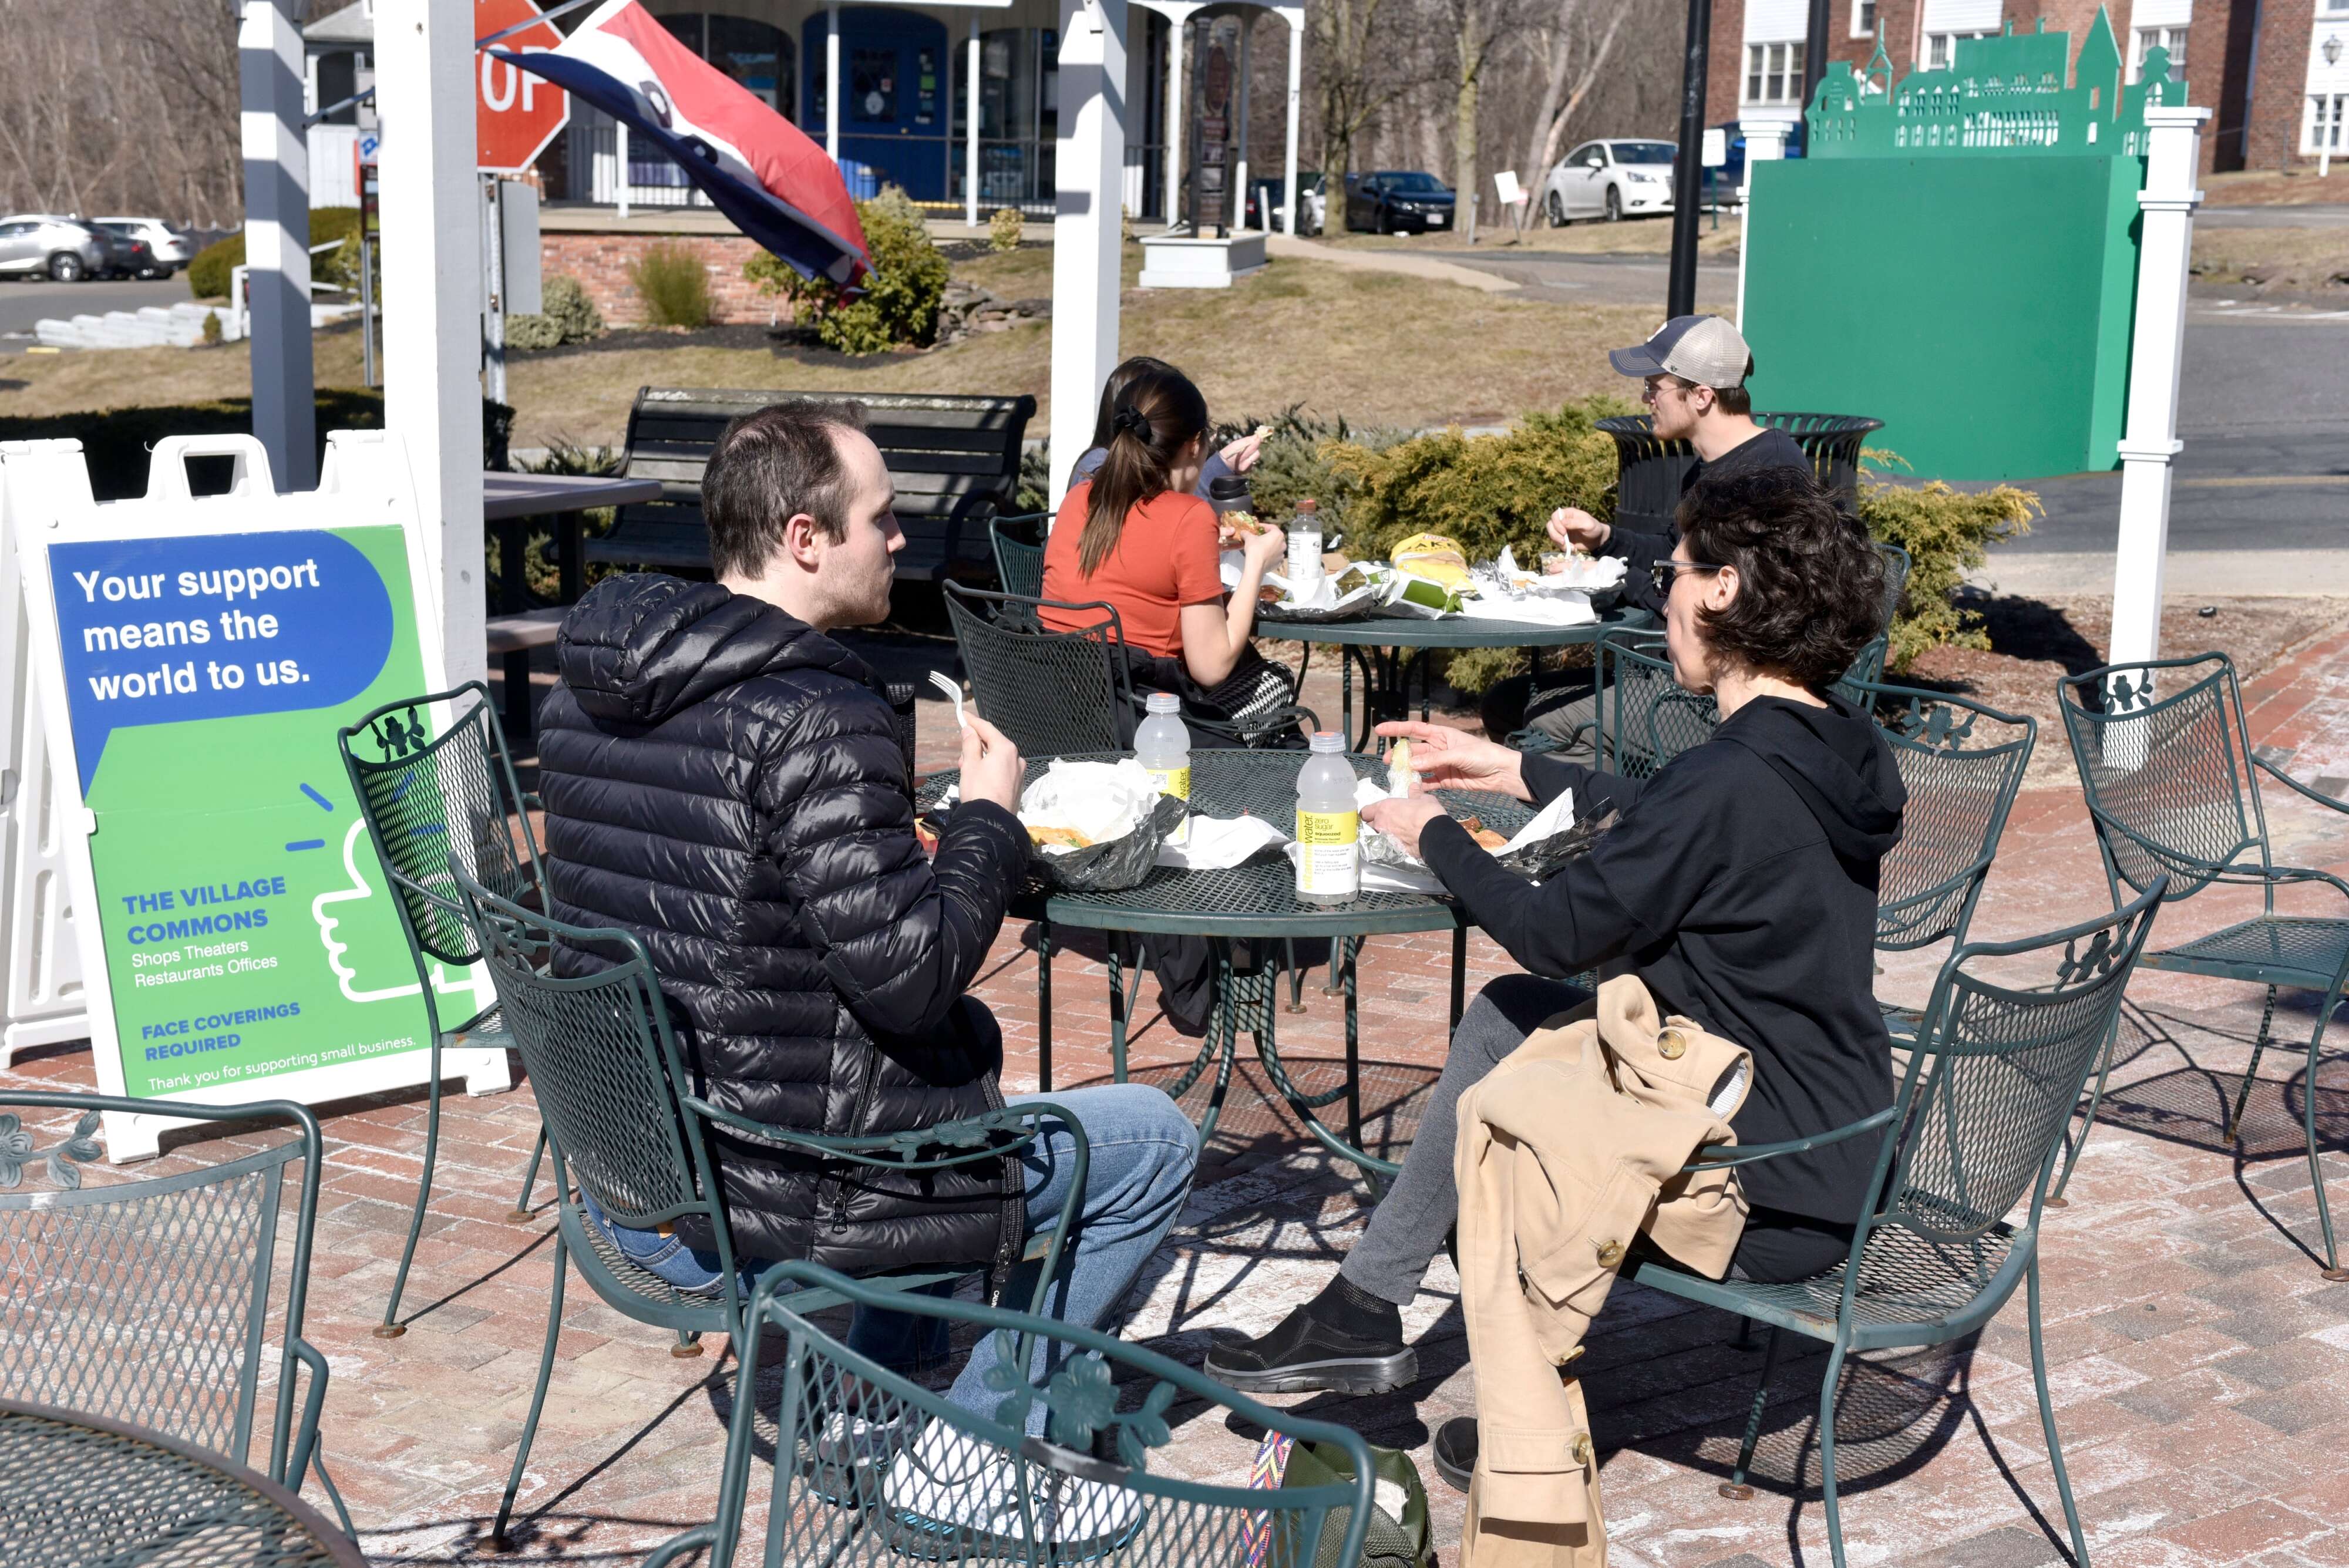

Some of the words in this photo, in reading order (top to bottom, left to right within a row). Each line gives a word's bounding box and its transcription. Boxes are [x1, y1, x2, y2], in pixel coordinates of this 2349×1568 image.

[474, 43, 550, 112] OP
[73, 571, 165, 603] Your
[178, 559, 320, 601] support
[83, 619, 210, 652] means
[220, 610, 278, 641] the
[89, 661, 197, 701] world
[207, 662, 245, 691] to
[256, 658, 310, 686] us.
[122, 891, 174, 914] THE
[180, 876, 286, 907] VILLAGE
[127, 909, 268, 945] COMMONS
[132, 950, 181, 968] Shops
[184, 941, 249, 961] Theaters
[134, 964, 224, 988] Restaurants
[230, 955, 278, 974] Offices
[142, 1020, 189, 1039] FACE
[194, 1002, 301, 1031] COVERINGS
[146, 1034, 241, 1061] REQUIRED
[148, 1073, 191, 1091] Thank
[194, 1071, 220, 1086] you
[222, 1064, 243, 1078] for
[245, 1051, 318, 1075] supporting
[321, 1045, 356, 1062] small
[359, 1037, 416, 1055] business.
